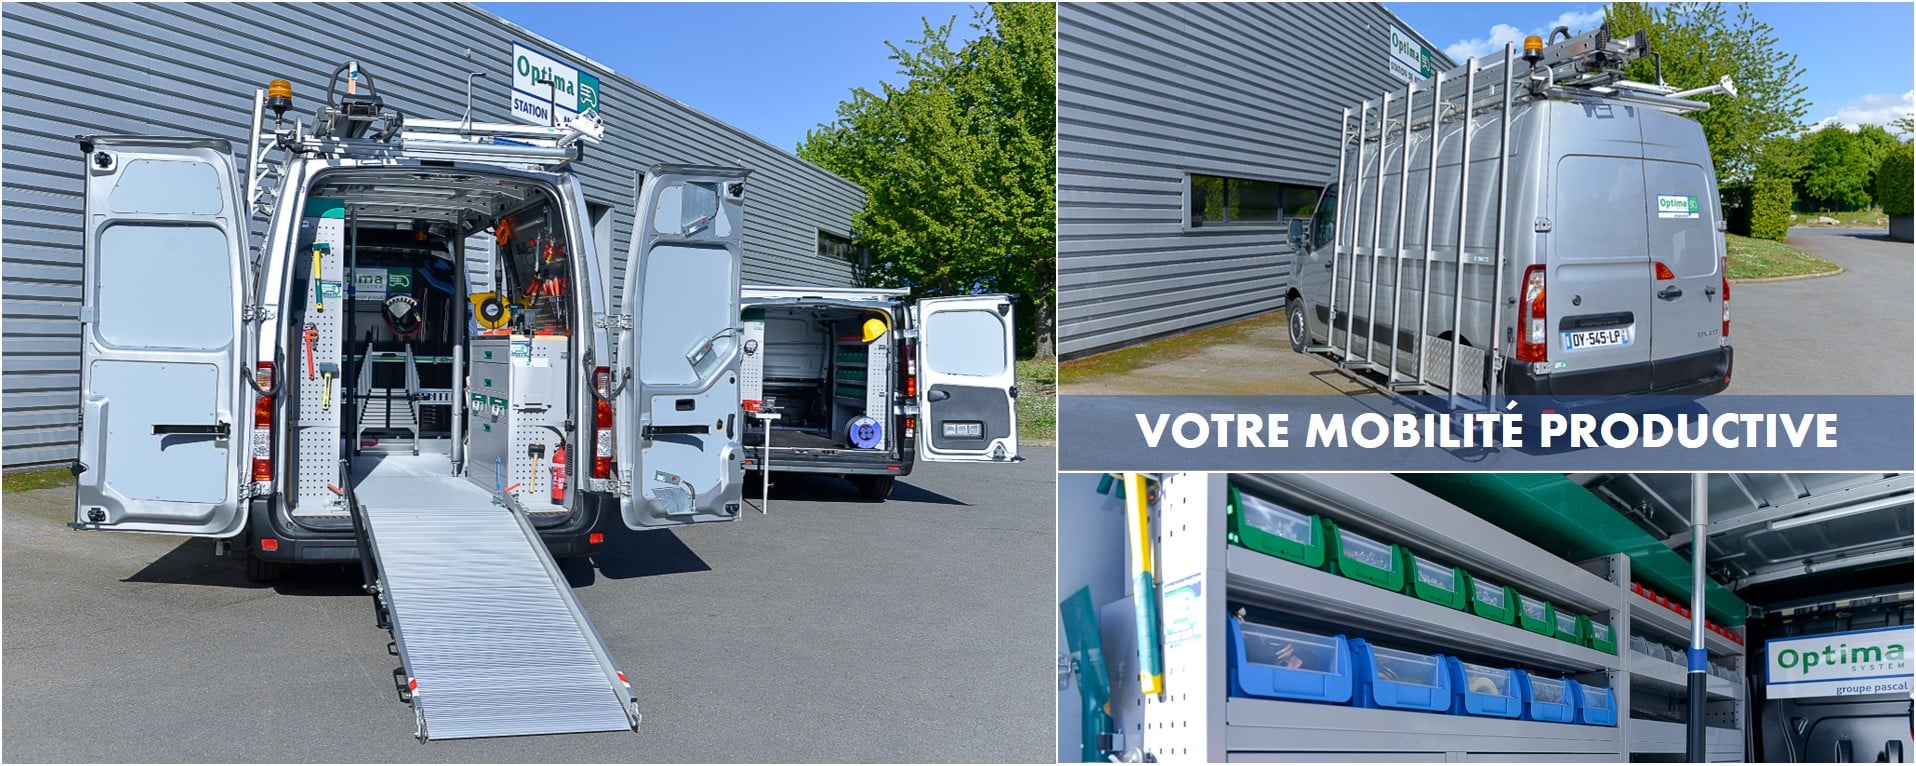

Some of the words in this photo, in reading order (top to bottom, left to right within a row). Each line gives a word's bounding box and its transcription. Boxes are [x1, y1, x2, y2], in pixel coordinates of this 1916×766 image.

[1391, 33, 1420, 62] Optima
[517, 55, 575, 96] Optima
[514, 98, 548, 120] STATION
[1660, 198, 1688, 209] Optima
[345, 272, 383, 284] tima
[1572, 330, 1620, 347] DY-545-LP
[1777, 643, 1905, 675] Optima
[1851, 663, 1905, 672] SYSTEM
[1836, 685, 1872, 696] groupe
[1874, 681, 1908, 693] pascal
